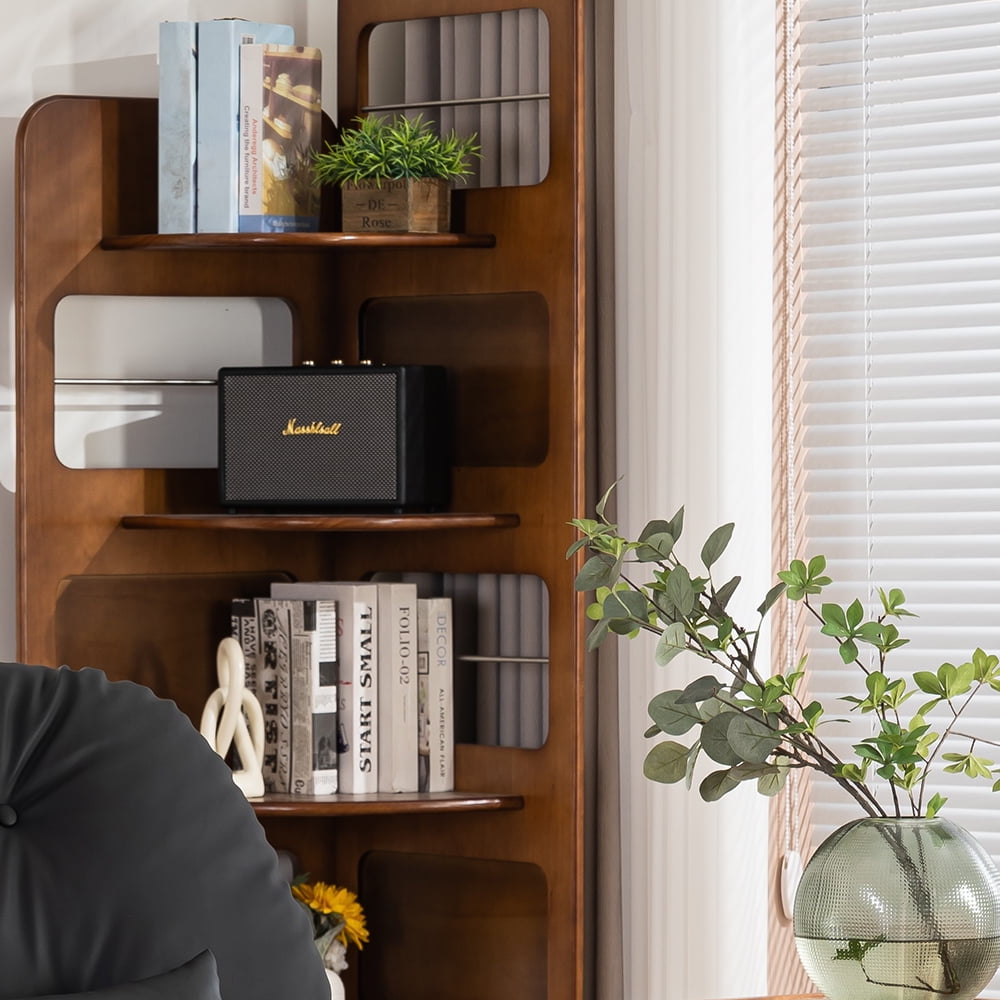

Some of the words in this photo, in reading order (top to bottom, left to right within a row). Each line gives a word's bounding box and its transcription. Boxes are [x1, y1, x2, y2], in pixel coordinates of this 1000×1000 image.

[361, 216, 392, 229] Rose
[359, 606, 372, 688] SMALL
[399, 606, 411, 685] FOLIO-02
[436, 615, 448, 667] DECOR
[359, 696, 372, 773] START
